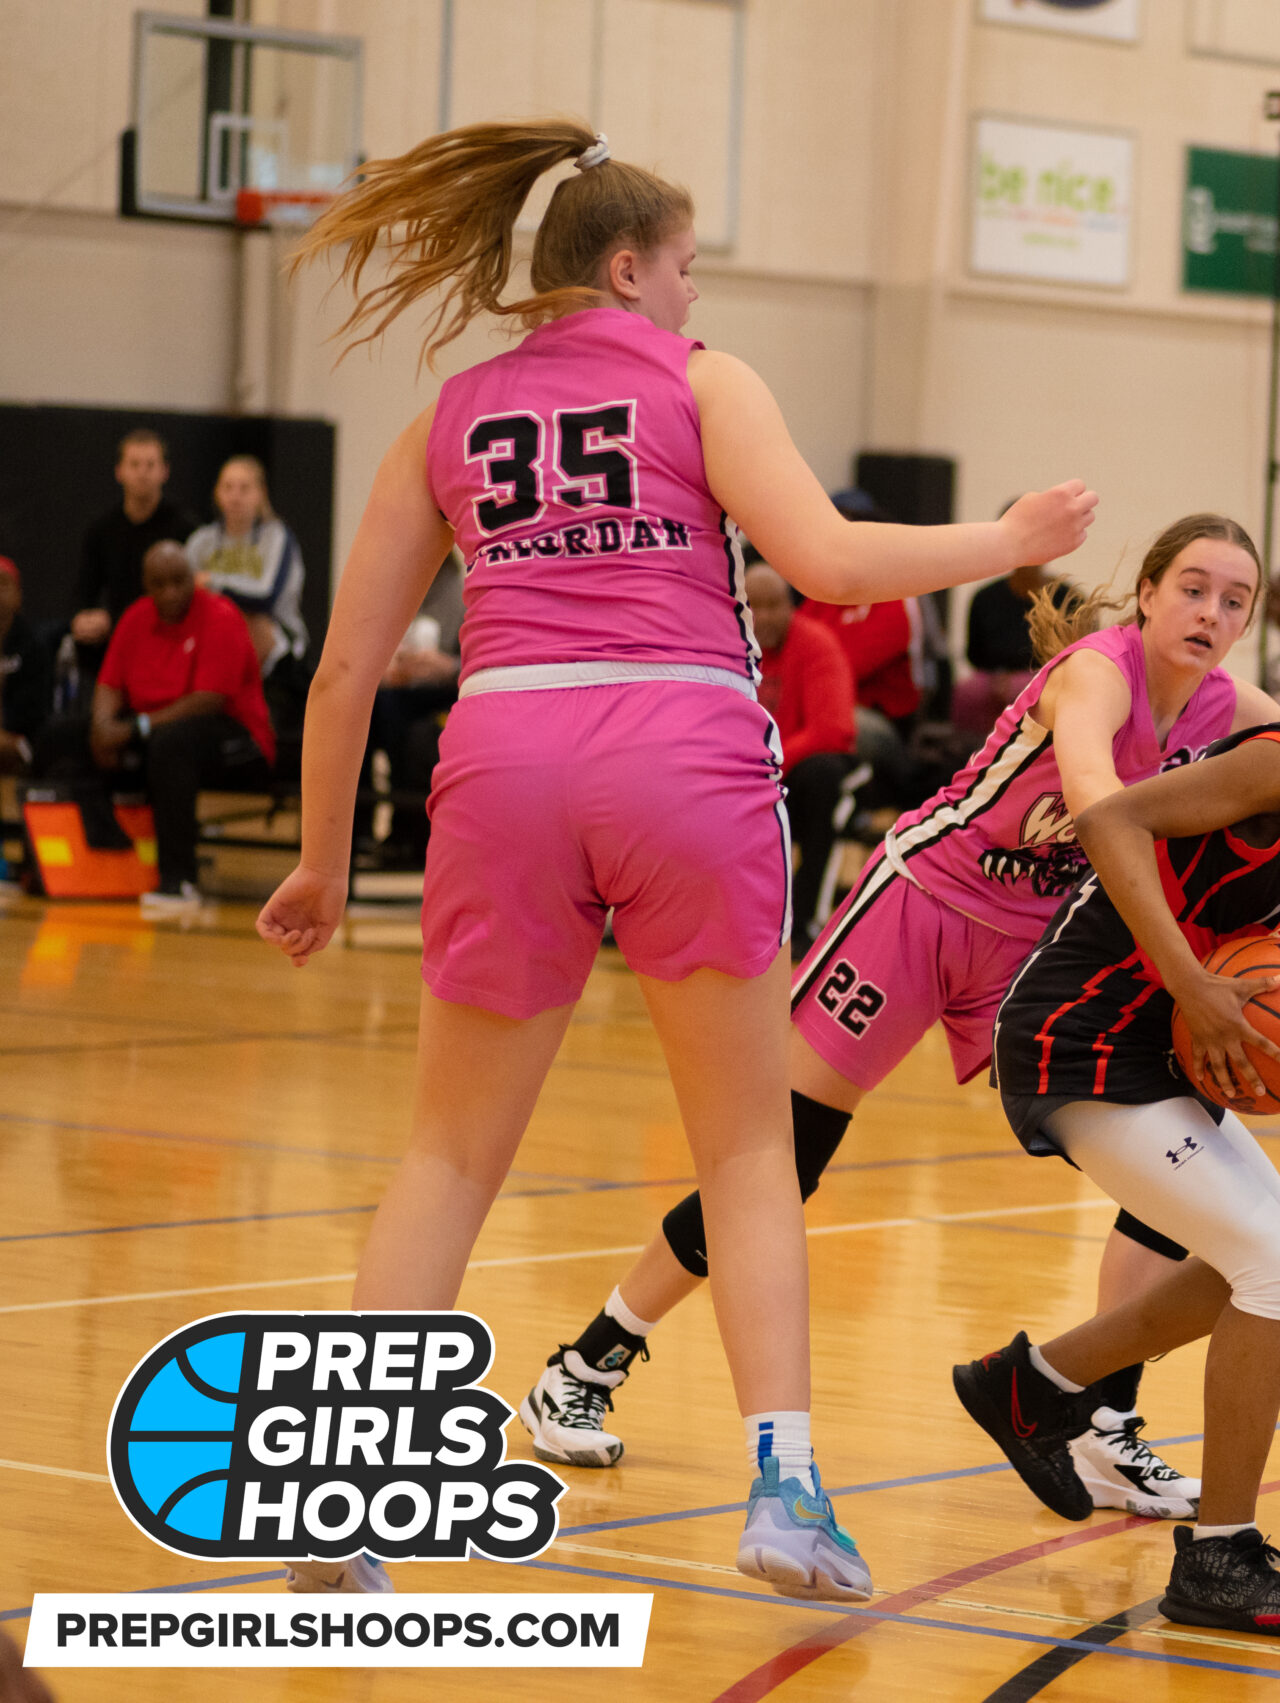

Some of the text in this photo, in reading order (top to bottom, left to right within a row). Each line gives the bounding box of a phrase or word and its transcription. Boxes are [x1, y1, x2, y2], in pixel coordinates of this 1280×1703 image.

[464, 399, 638, 538] 35
[466, 515, 693, 577] RIORDAN
[815, 958, 888, 1040] 22
